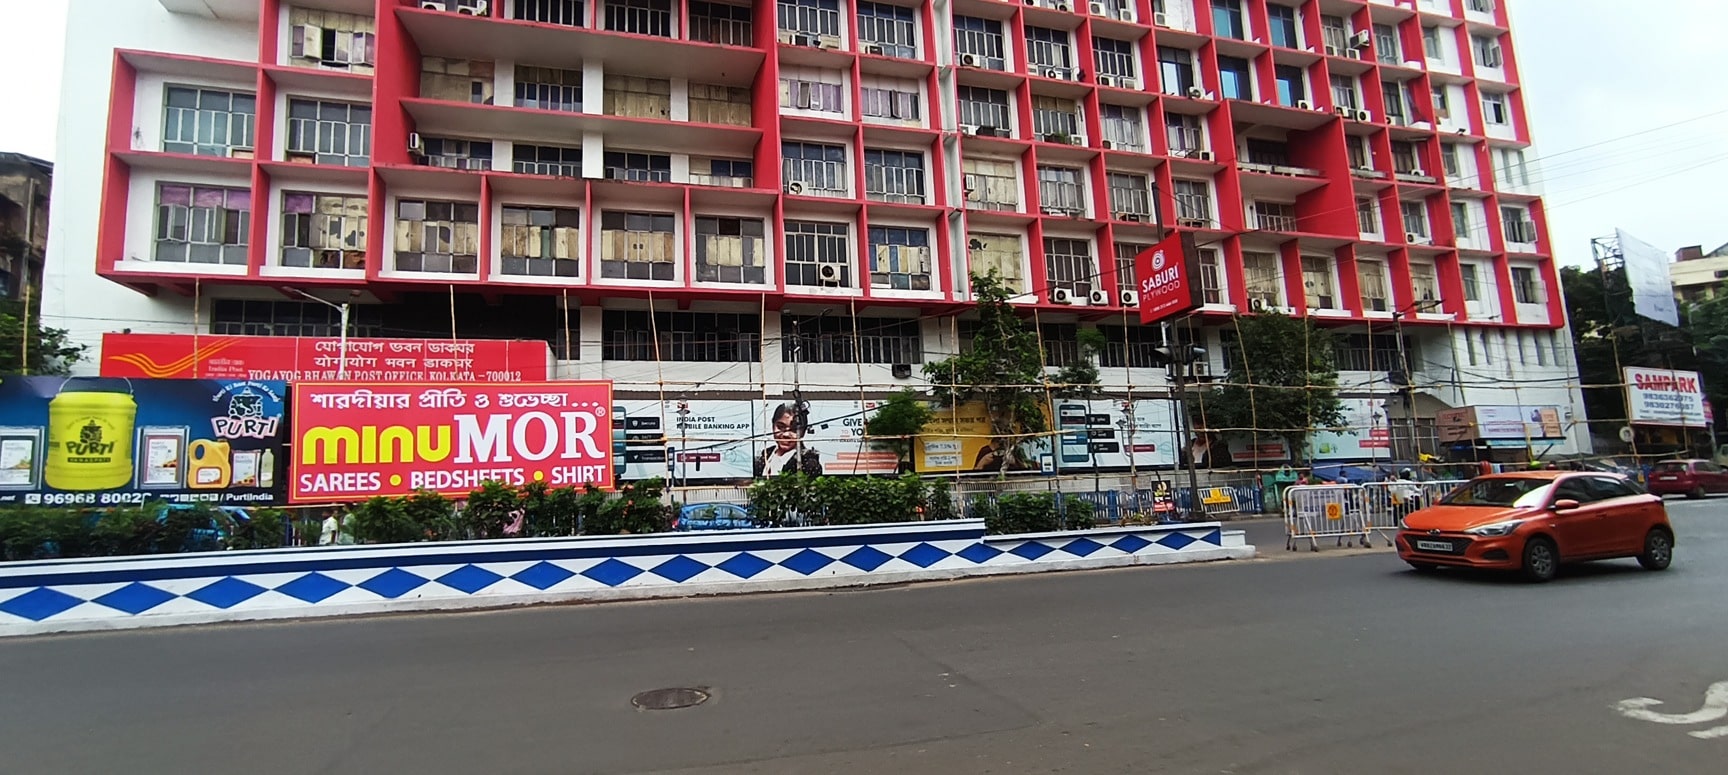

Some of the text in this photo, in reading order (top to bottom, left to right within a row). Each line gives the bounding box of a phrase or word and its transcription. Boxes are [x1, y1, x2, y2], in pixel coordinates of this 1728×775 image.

[1142, 265, 1179, 293] SABURI
[1142, 280, 1180, 302] PLYWOOD
[389, 342, 423, 353] ভবন
[386, 357, 416, 368] भवन
[248, 370, 301, 381] YOGAYOG
[354, 370, 382, 380] POST
[384, 370, 423, 380] OFFICE
[429, 371, 475, 381] KOLKATA
[1635, 373, 1697, 393] SAMPARK
[310, 389, 411, 409] শারদীয়ার
[419, 389, 467, 409] প্রীতি
[475, 394, 490, 408] ও
[214, 418, 276, 437] PURTI
[842, 418, 862, 427] GIVE
[65, 441, 115, 455] PURTI
[300, 465, 607, 492] SAREES BEDSHEETS SHIRT
[43, 492, 96, 504] 96968
